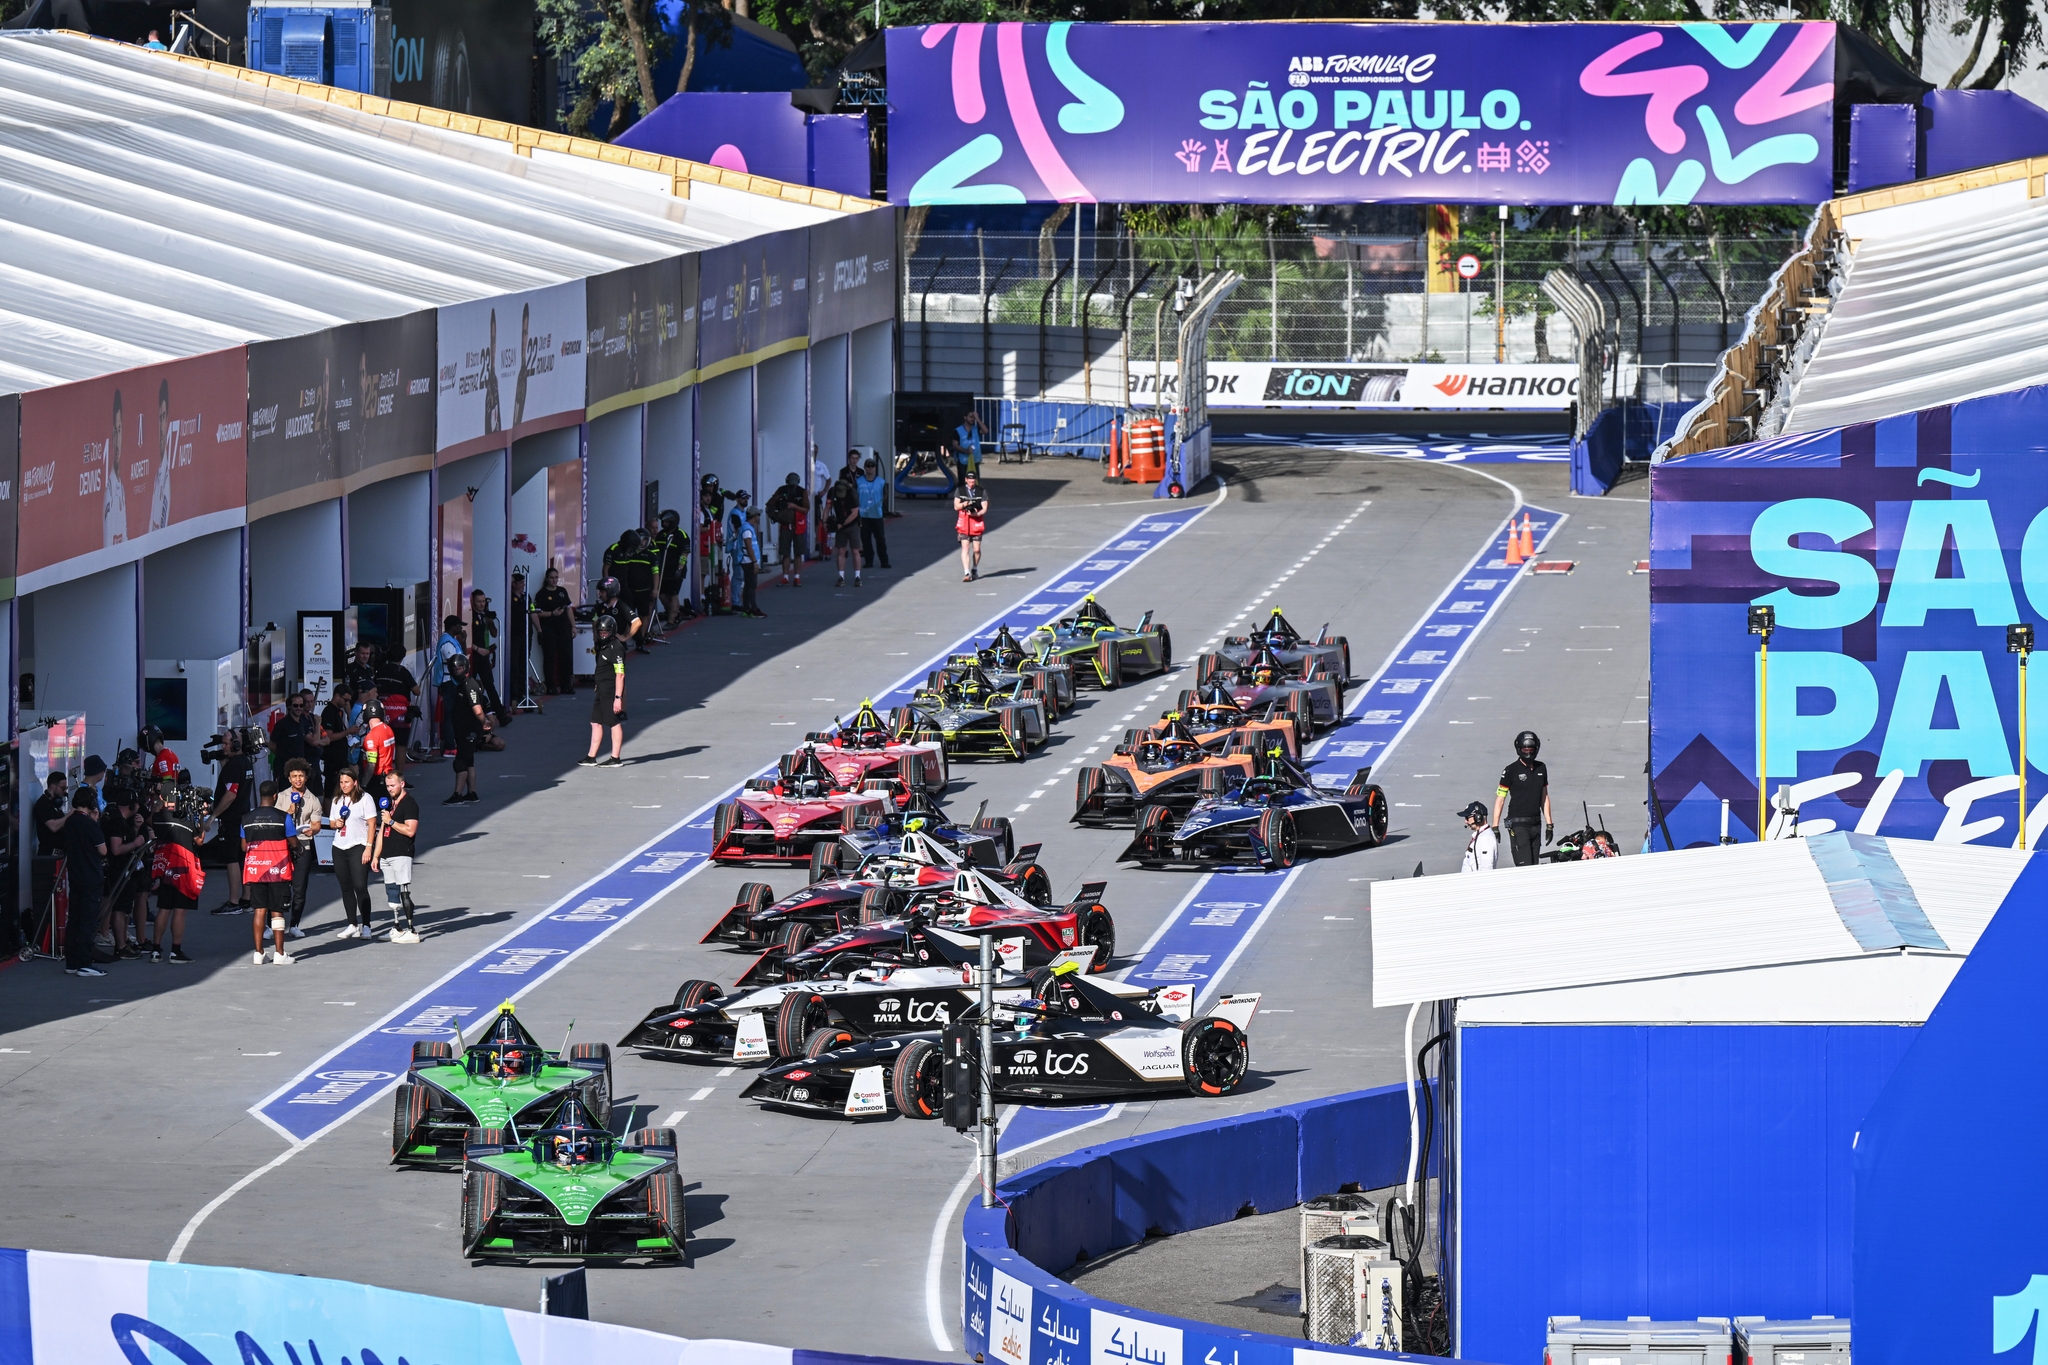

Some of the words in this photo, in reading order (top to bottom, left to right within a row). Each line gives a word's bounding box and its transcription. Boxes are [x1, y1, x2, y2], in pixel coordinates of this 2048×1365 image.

[1288, 56, 1324, 72] ABB
[1324, 54, 1409, 74] FORMULA
[1199, 80, 1319, 130] SÃO
[1334, 89, 1532, 130] PAULO.
[1236, 125, 1473, 178] ELECTRIC.
[501, 347, 518, 369] NISSAN
[526, 336, 539, 377] 22
[130, 459, 150, 480] ANDRETTI
[79, 468, 101, 497] DENNIS
[1749, 467, 2048, 630] SÃ
[313, 643, 322, 655] 2
[1755, 650, 2048, 778] PA
[873, 1014, 902, 1022] TATA
[1139, 1000, 1157, 1013] 37
[1045, 1049, 1090, 1075] tcs
[1143, 1049, 1176, 1058] Wolfspeed
[1008, 1066, 1039, 1075] TATA
[1139, 1063, 1180, 1071] JAGUAR
[287, 1081, 370, 1105] Allianz
[793, 1090, 809, 1099] FIA
[996, 1284, 1025, 1325] سابك
[1037, 1304, 1080, 1347] سابك
[1001, 1327, 1022, 1360] sabic
